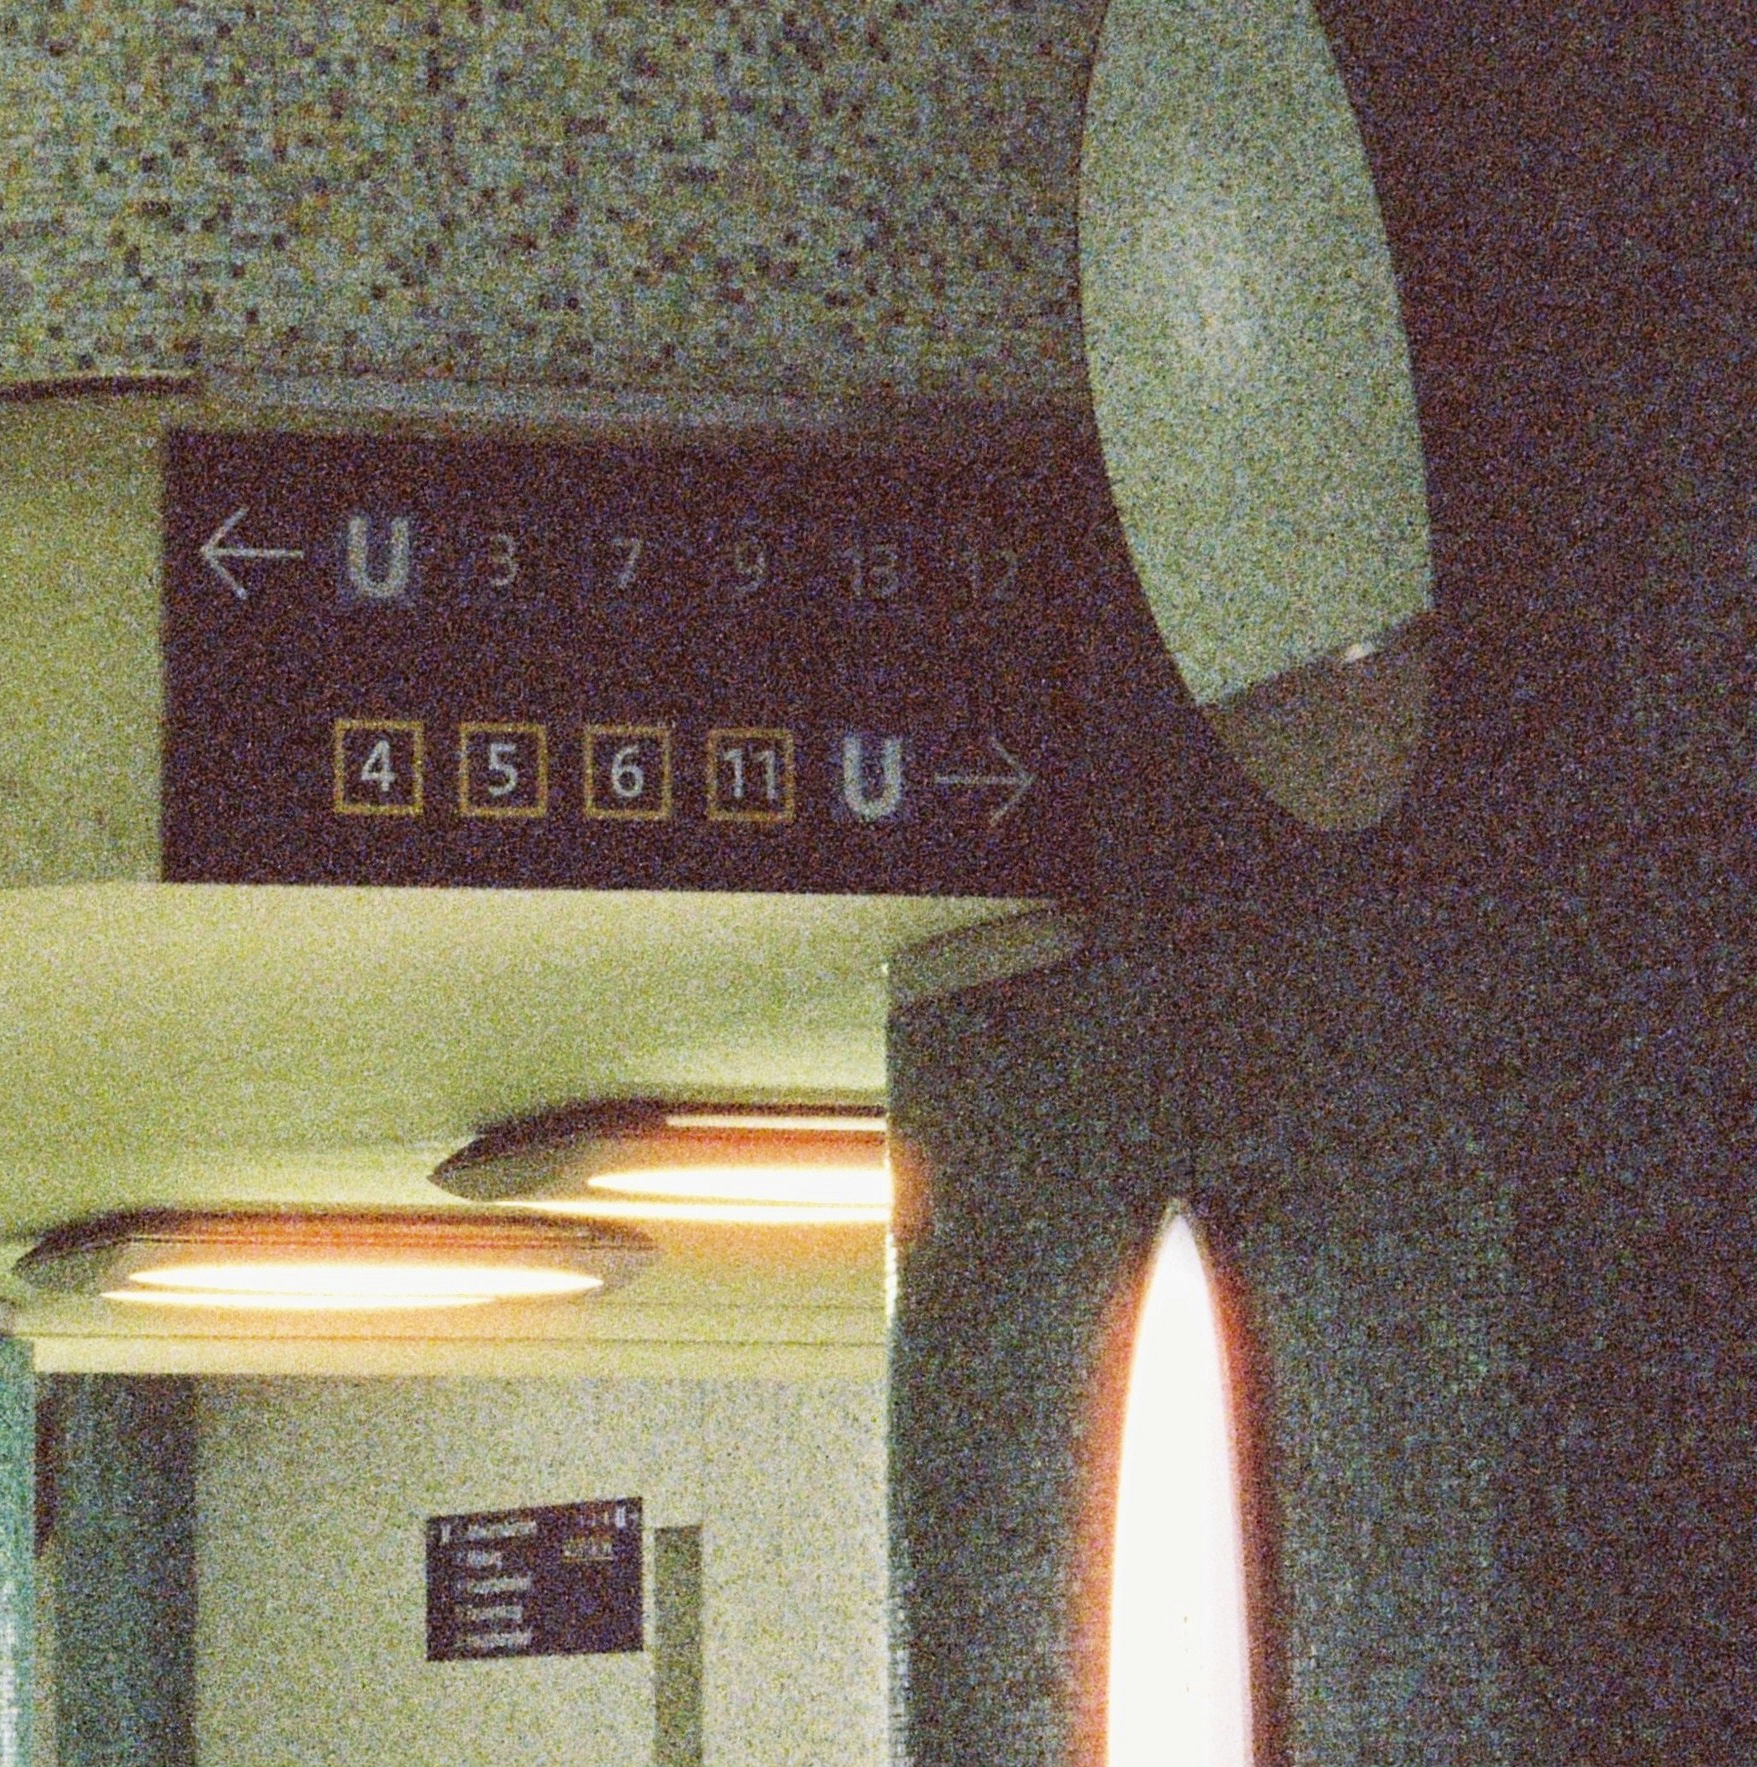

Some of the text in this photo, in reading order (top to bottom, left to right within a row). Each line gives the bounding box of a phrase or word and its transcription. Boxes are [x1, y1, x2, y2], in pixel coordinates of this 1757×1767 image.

[348, 517, 410, 598] U
[489, 535, 519, 588] 3
[615, 537, 645, 589] 7
[735, 541, 766, 593] 9
[359, 733, 902, 818] 4 5 6 11 U
